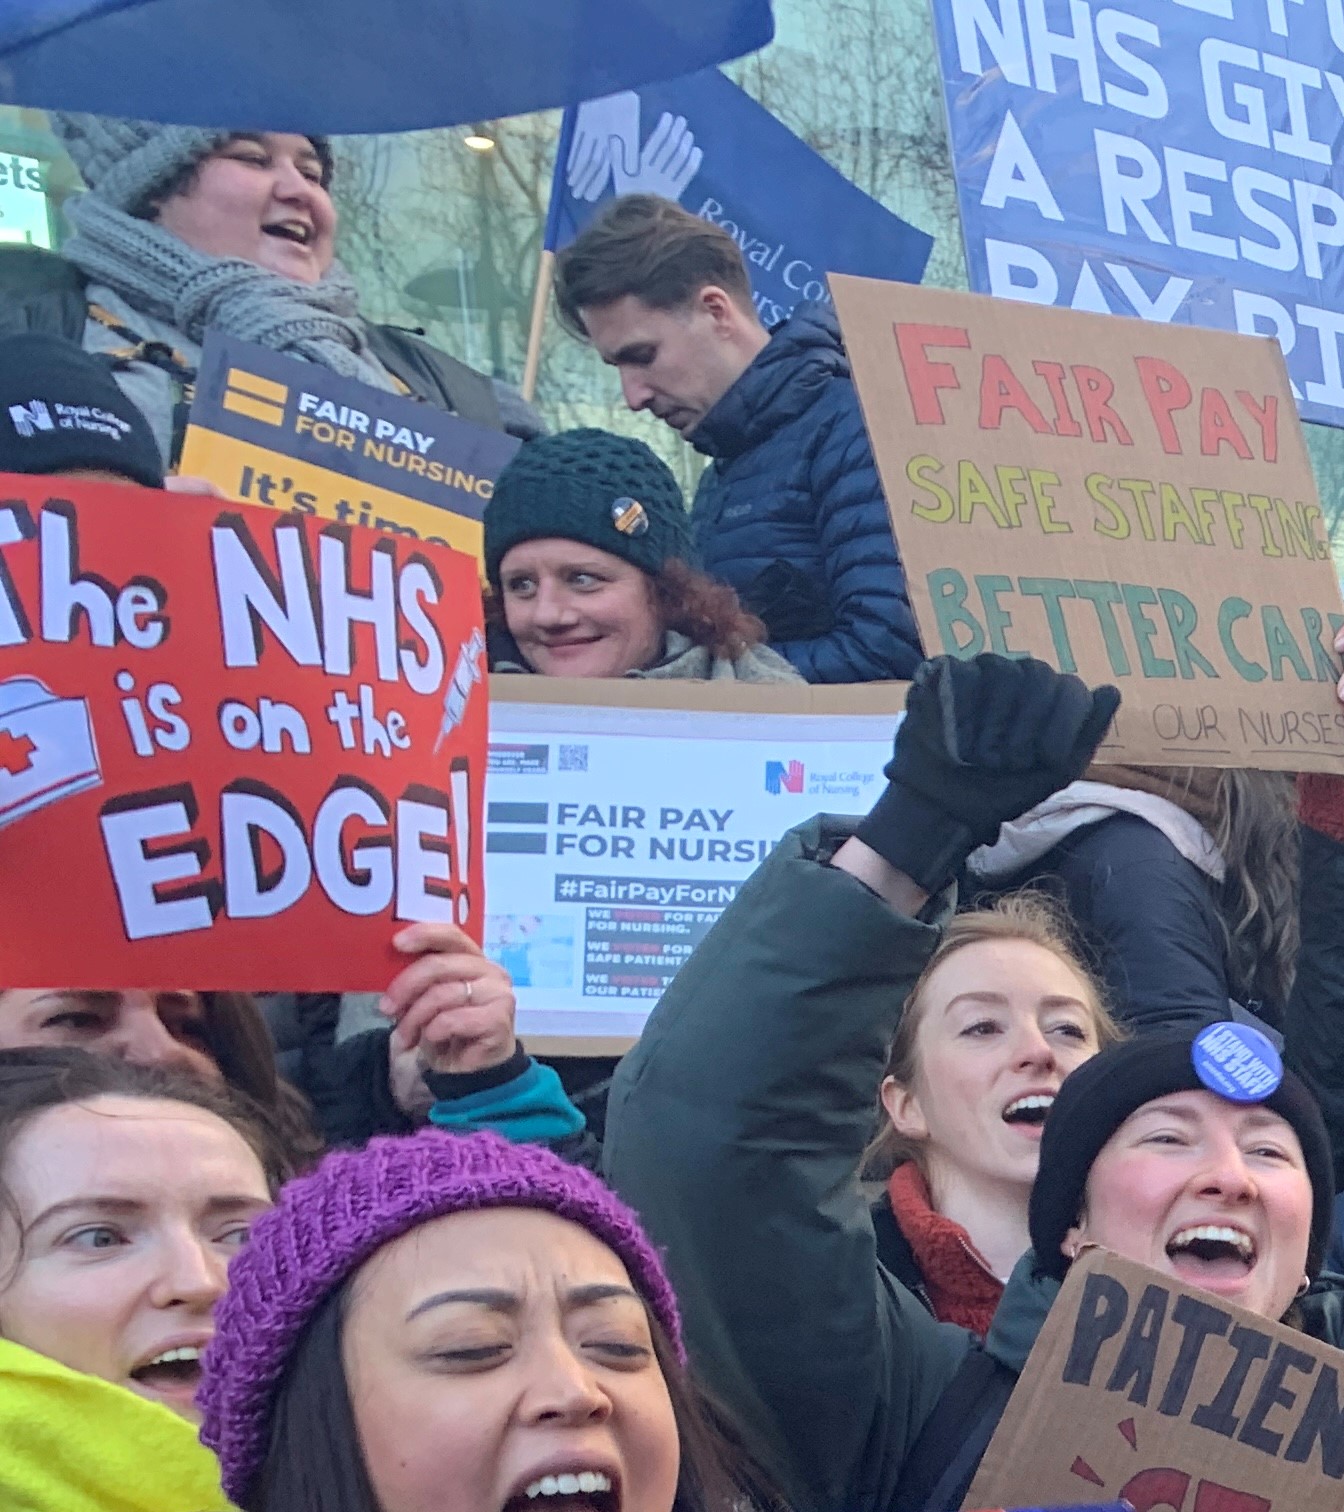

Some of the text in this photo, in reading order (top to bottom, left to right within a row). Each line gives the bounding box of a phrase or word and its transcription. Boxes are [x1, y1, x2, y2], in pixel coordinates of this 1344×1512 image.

[950, 0, 1169, 119] NHS
[981, 108, 1065, 222] A
[893, 322, 1279, 463] FAIR PAY
[298, 392, 436, 454] FAIR PAY
[296, 415, 495, 499] FOR NURSING
[239, 465, 318, 515] It's
[906, 453, 1332, 562] SAFE STAFFING
[0, 503, 446, 695] The NHS
[925, 567, 1219, 680] BETTER
[115, 669, 412, 757] is on the
[1153, 703, 1227, 741] OUR
[808, 783, 860, 797] of Nursing
[809, 771, 875, 784] Royal College
[557, 803, 735, 832] FAIR PAY
[100, 757, 471, 941] EDGE!
[556, 833, 635, 858] FOR
[559, 880, 736, 905] #FairPayForN
[587, 921, 617, 931] FOR
[588, 909, 612, 920] WE
[664, 912, 694, 922] FOR
[587, 941, 611, 951] WE
[662, 945, 693, 955] FOR
[587, 953, 621, 964] SAFE
[585, 985, 617, 996] OUR
[586, 973, 609, 984] WE
